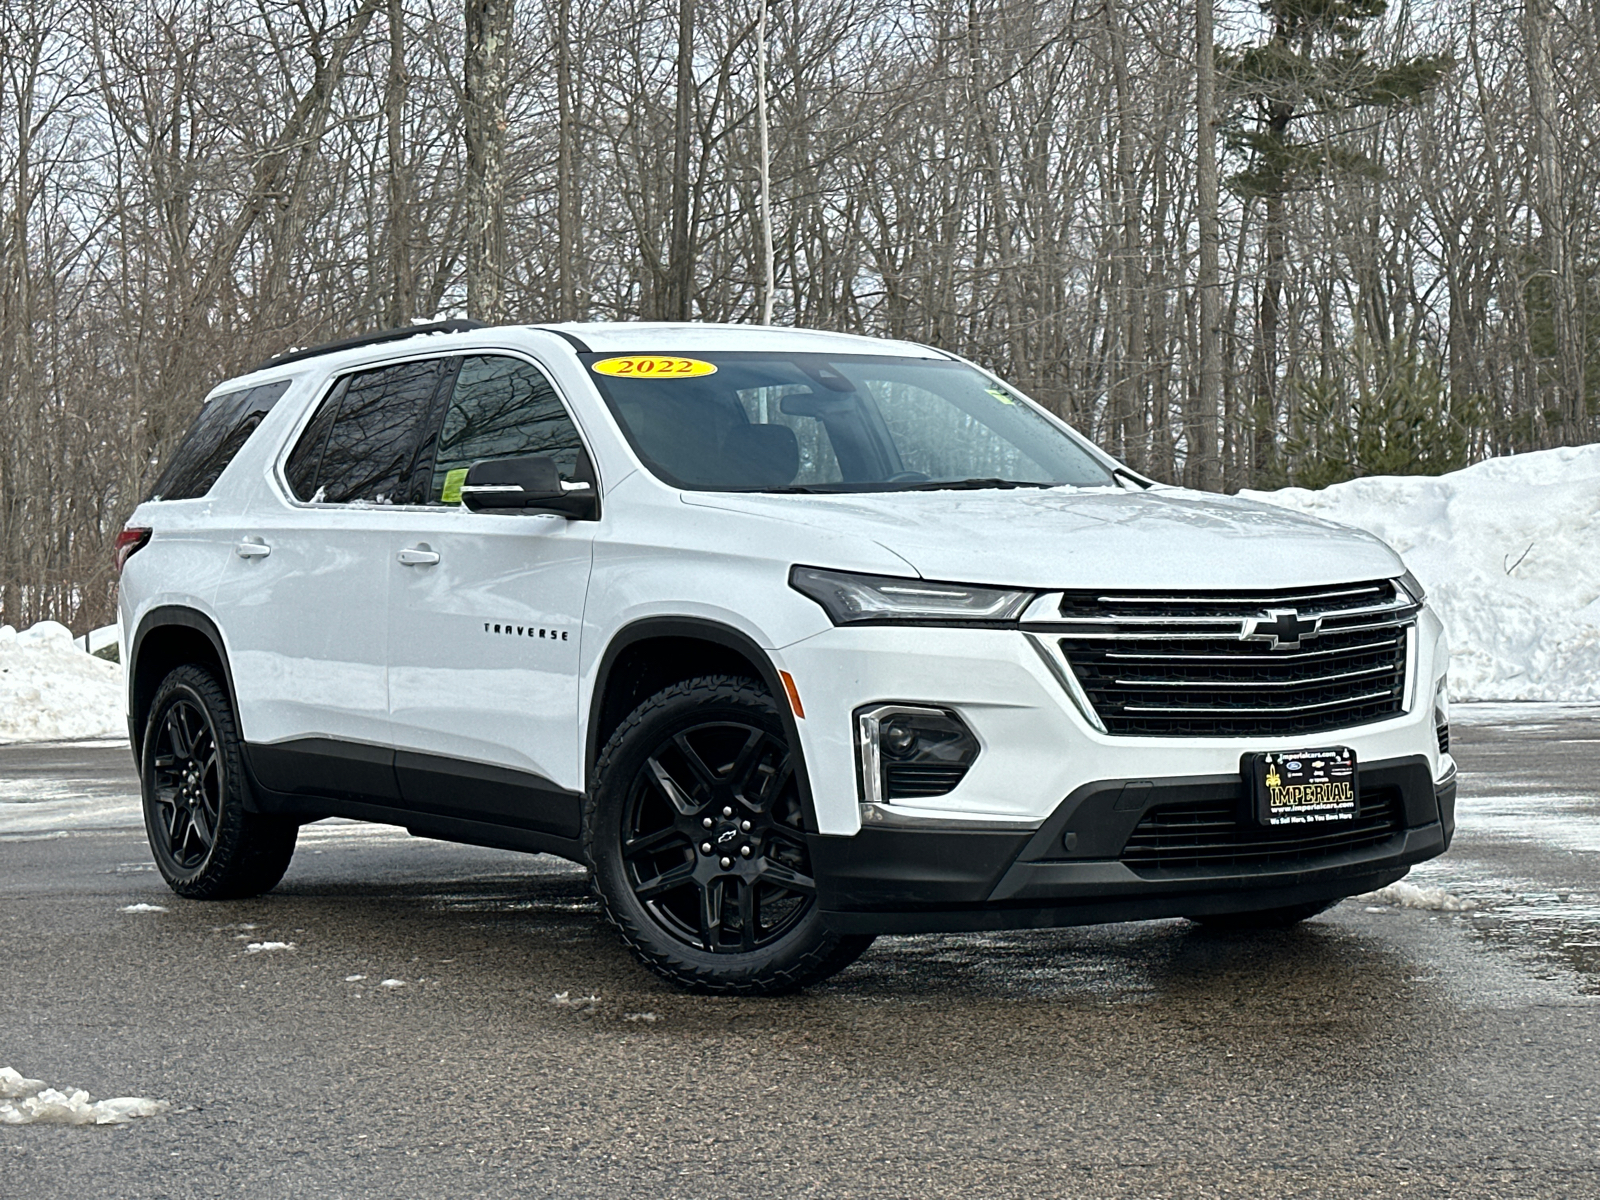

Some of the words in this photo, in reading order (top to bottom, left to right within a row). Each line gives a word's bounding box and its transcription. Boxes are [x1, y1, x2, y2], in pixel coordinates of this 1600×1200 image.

[616, 360, 693, 374] 2022
[484, 622, 568, 641] TRAVERSE
[1270, 782, 1354, 807] IMPERIAL
